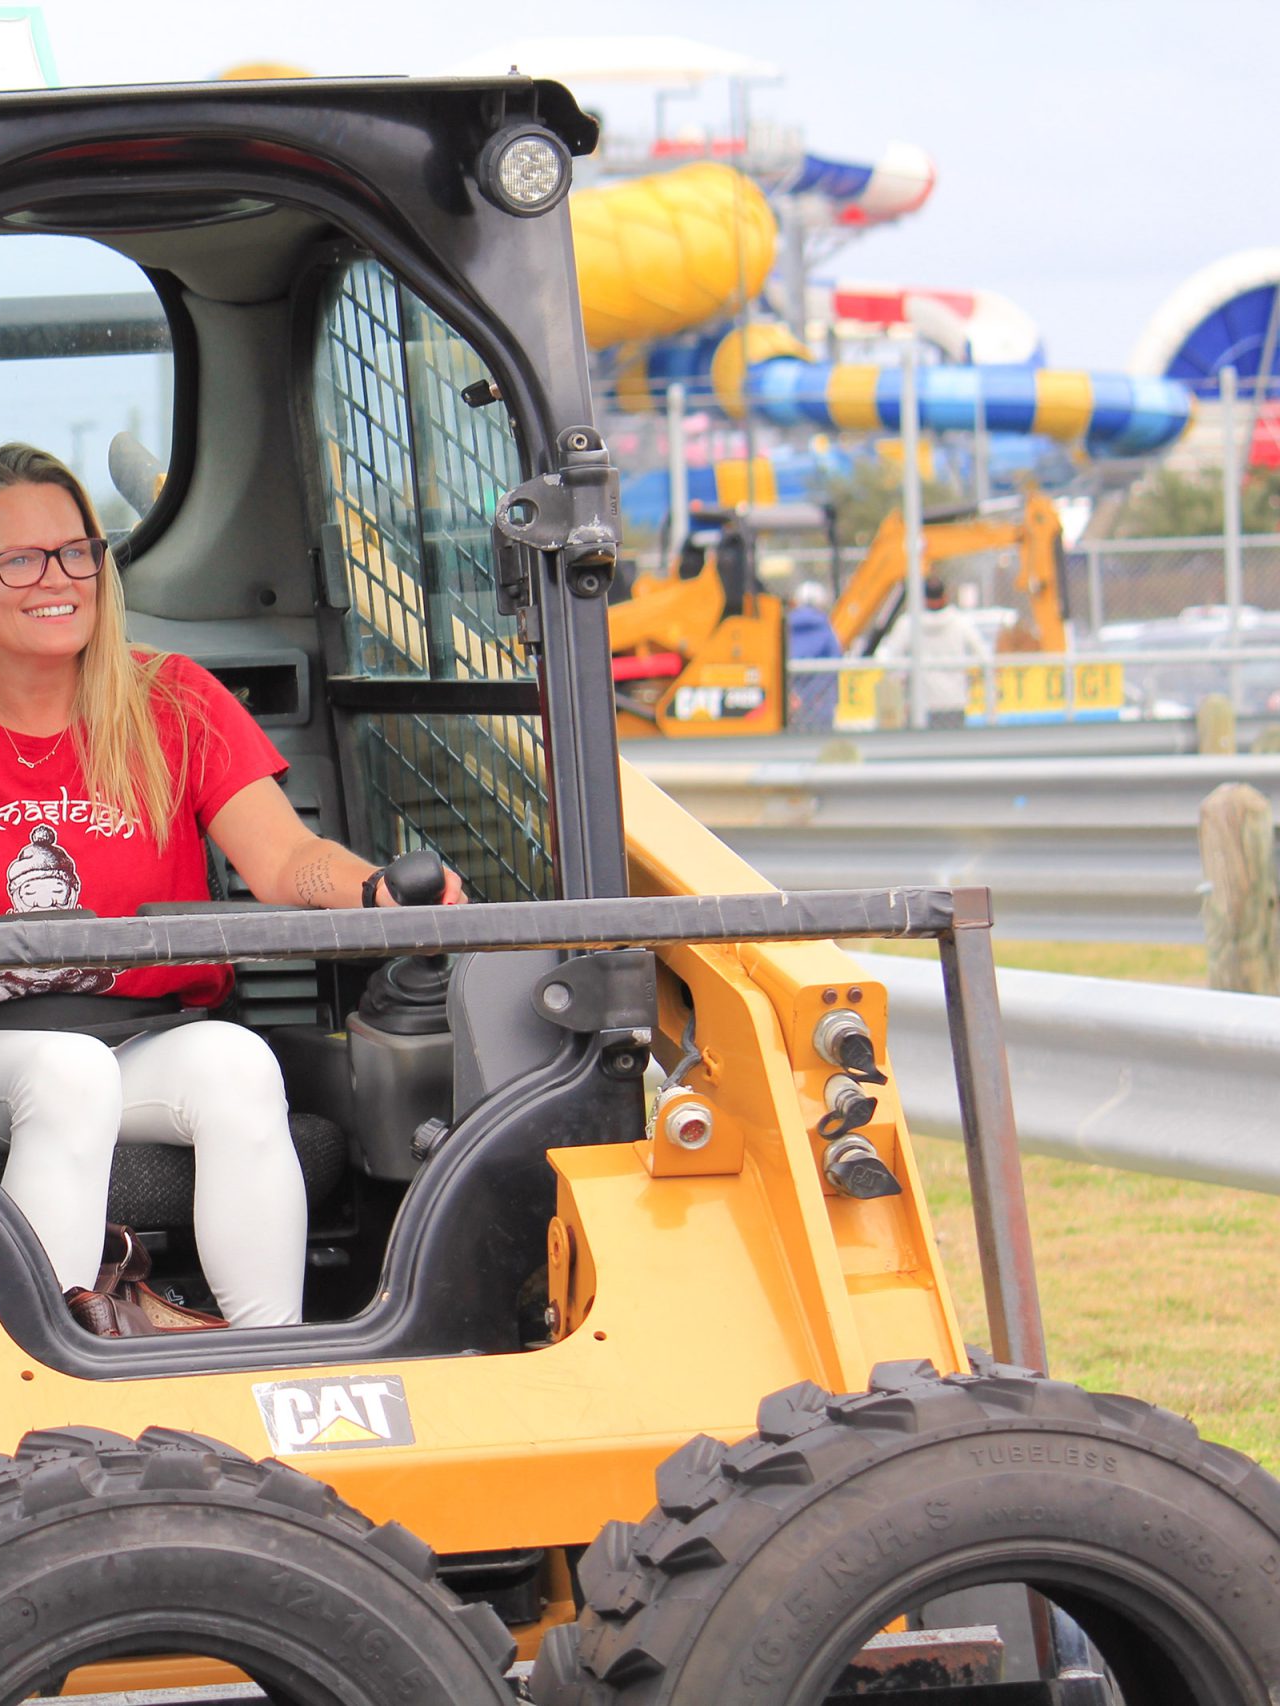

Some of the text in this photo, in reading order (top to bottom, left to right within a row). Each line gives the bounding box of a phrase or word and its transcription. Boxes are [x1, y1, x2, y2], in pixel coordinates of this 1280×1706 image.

[675, 687, 722, 721] CAT
[272, 1382, 392, 1445] CAT
[968, 1443, 1119, 1474] TUBELESS
